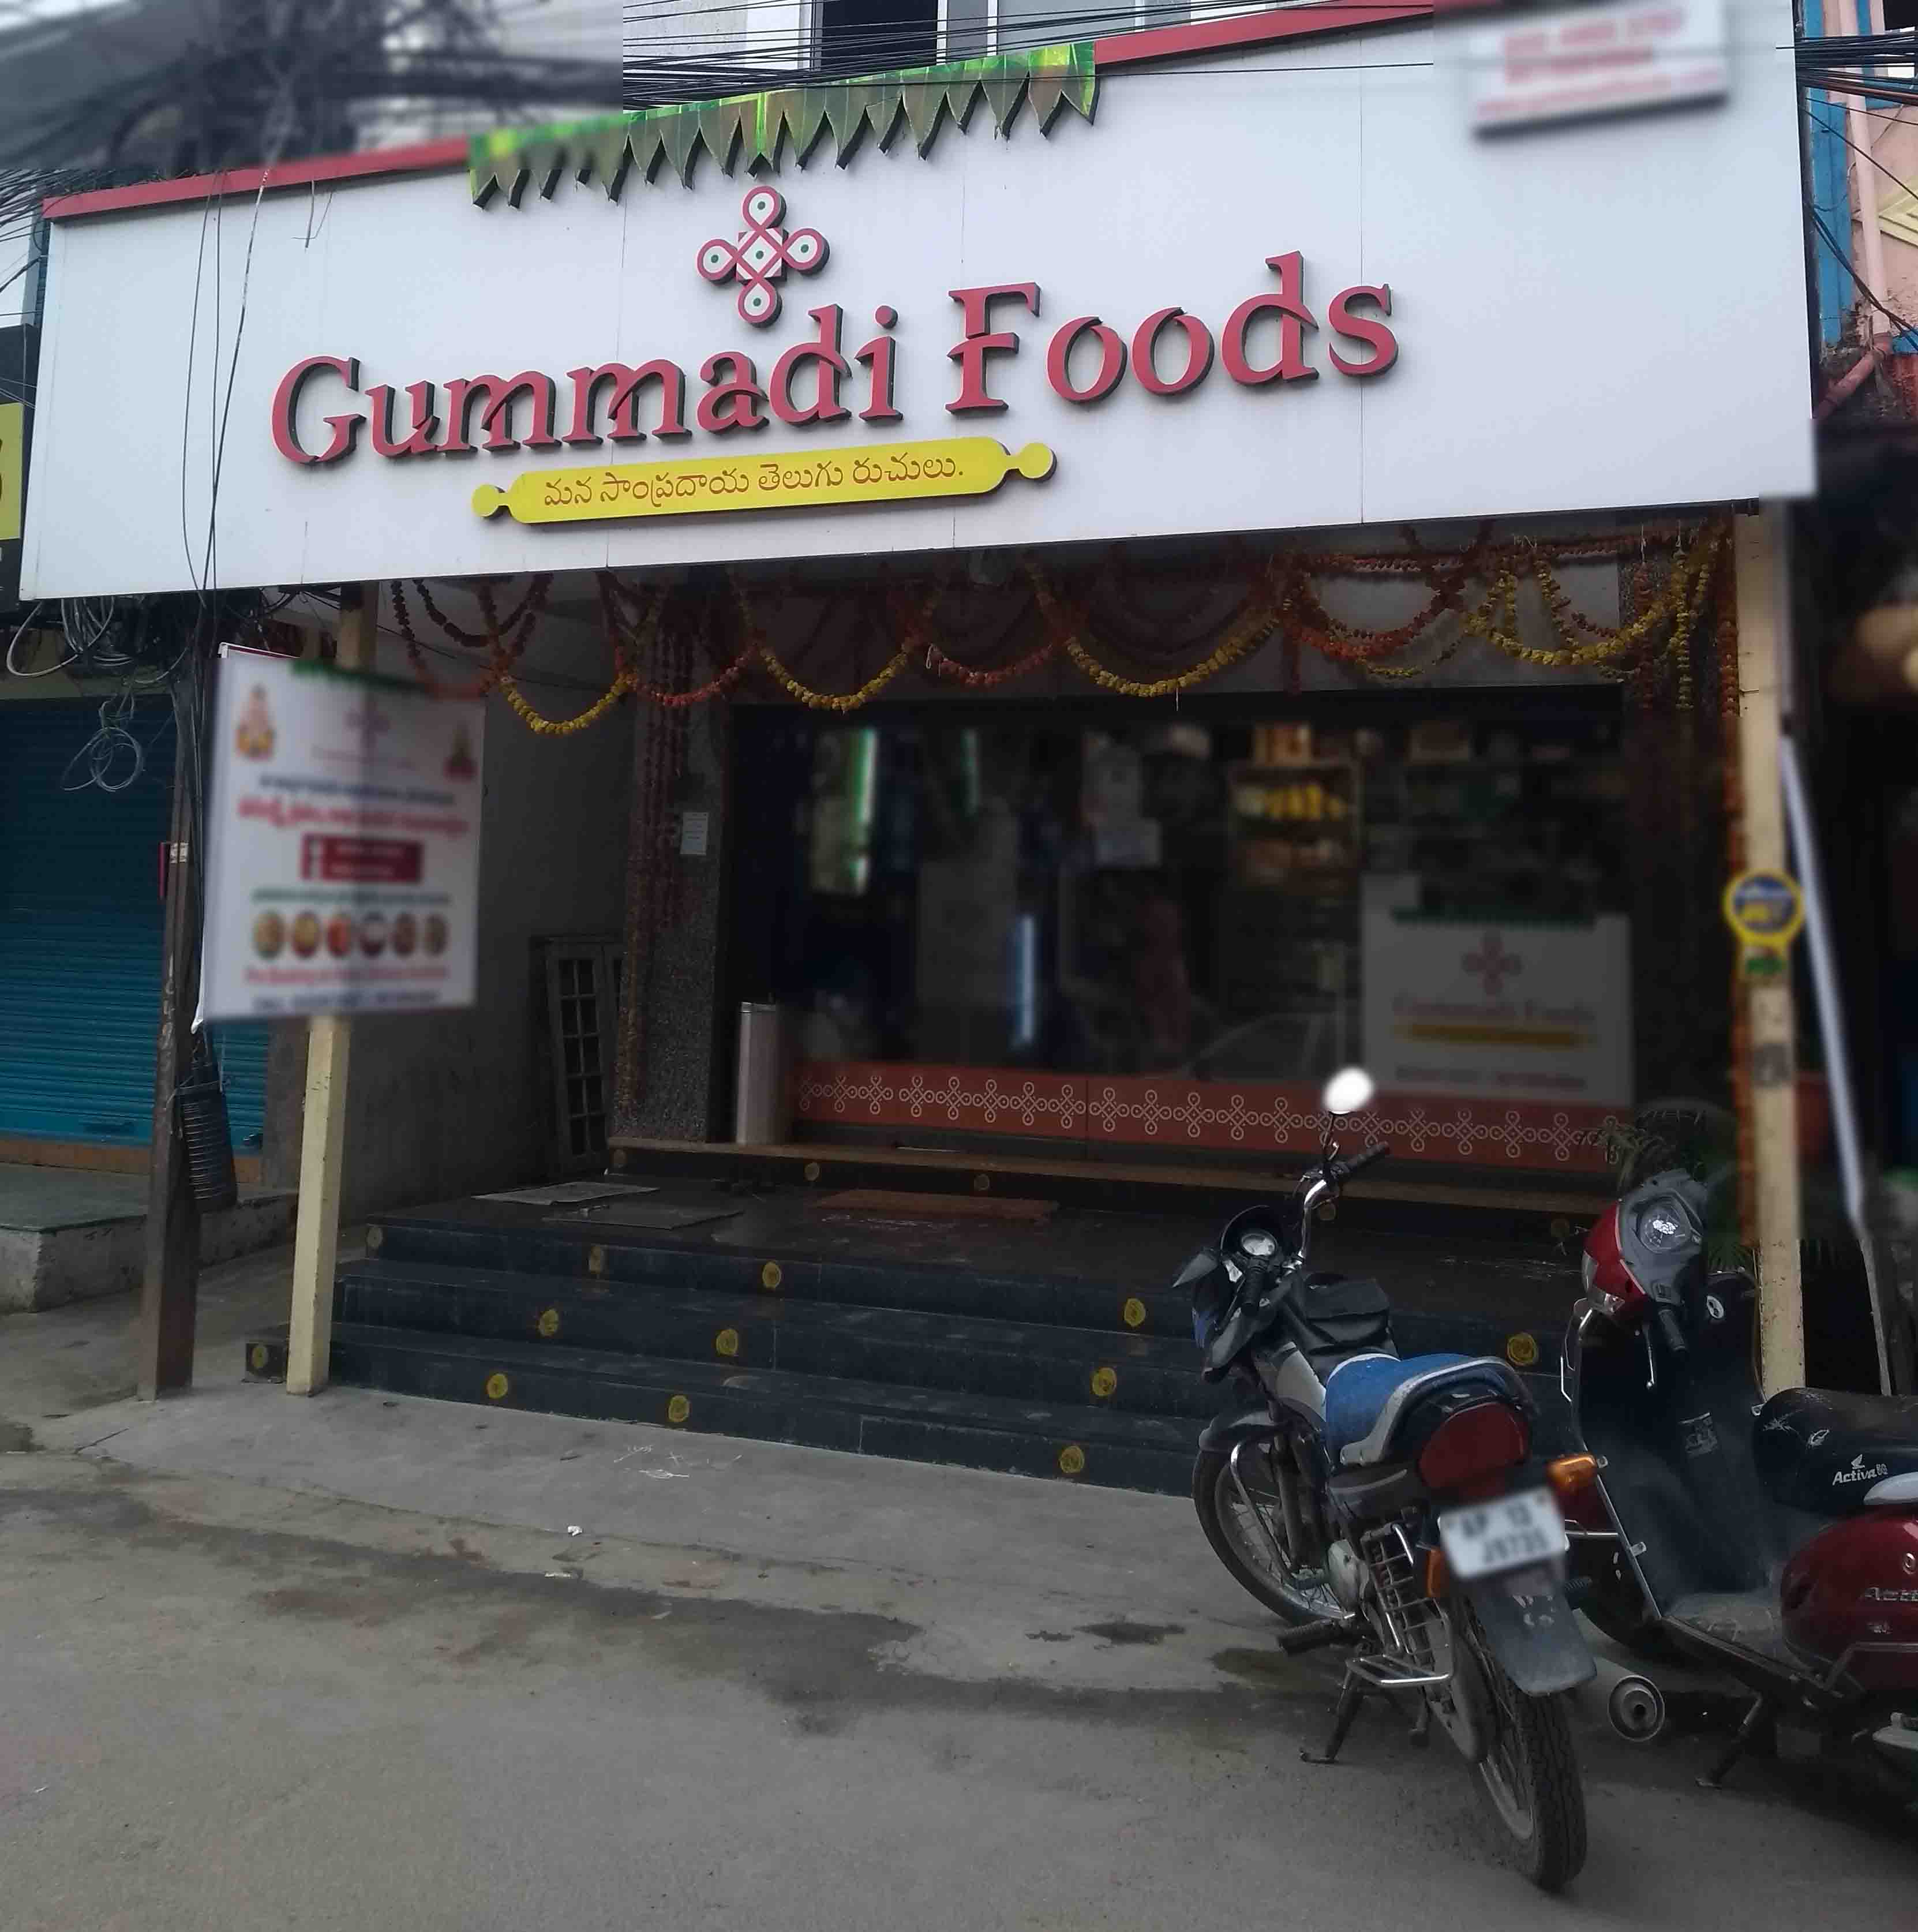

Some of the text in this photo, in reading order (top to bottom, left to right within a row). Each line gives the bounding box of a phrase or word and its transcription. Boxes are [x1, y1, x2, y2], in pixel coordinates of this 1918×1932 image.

[271, 250, 1399, 464] Gummadi Foods
[544, 452, 964, 507] మన సాంప్రదాయ తెలుగు రుచులు.
[1832, 1468, 1877, 1486] Activa
